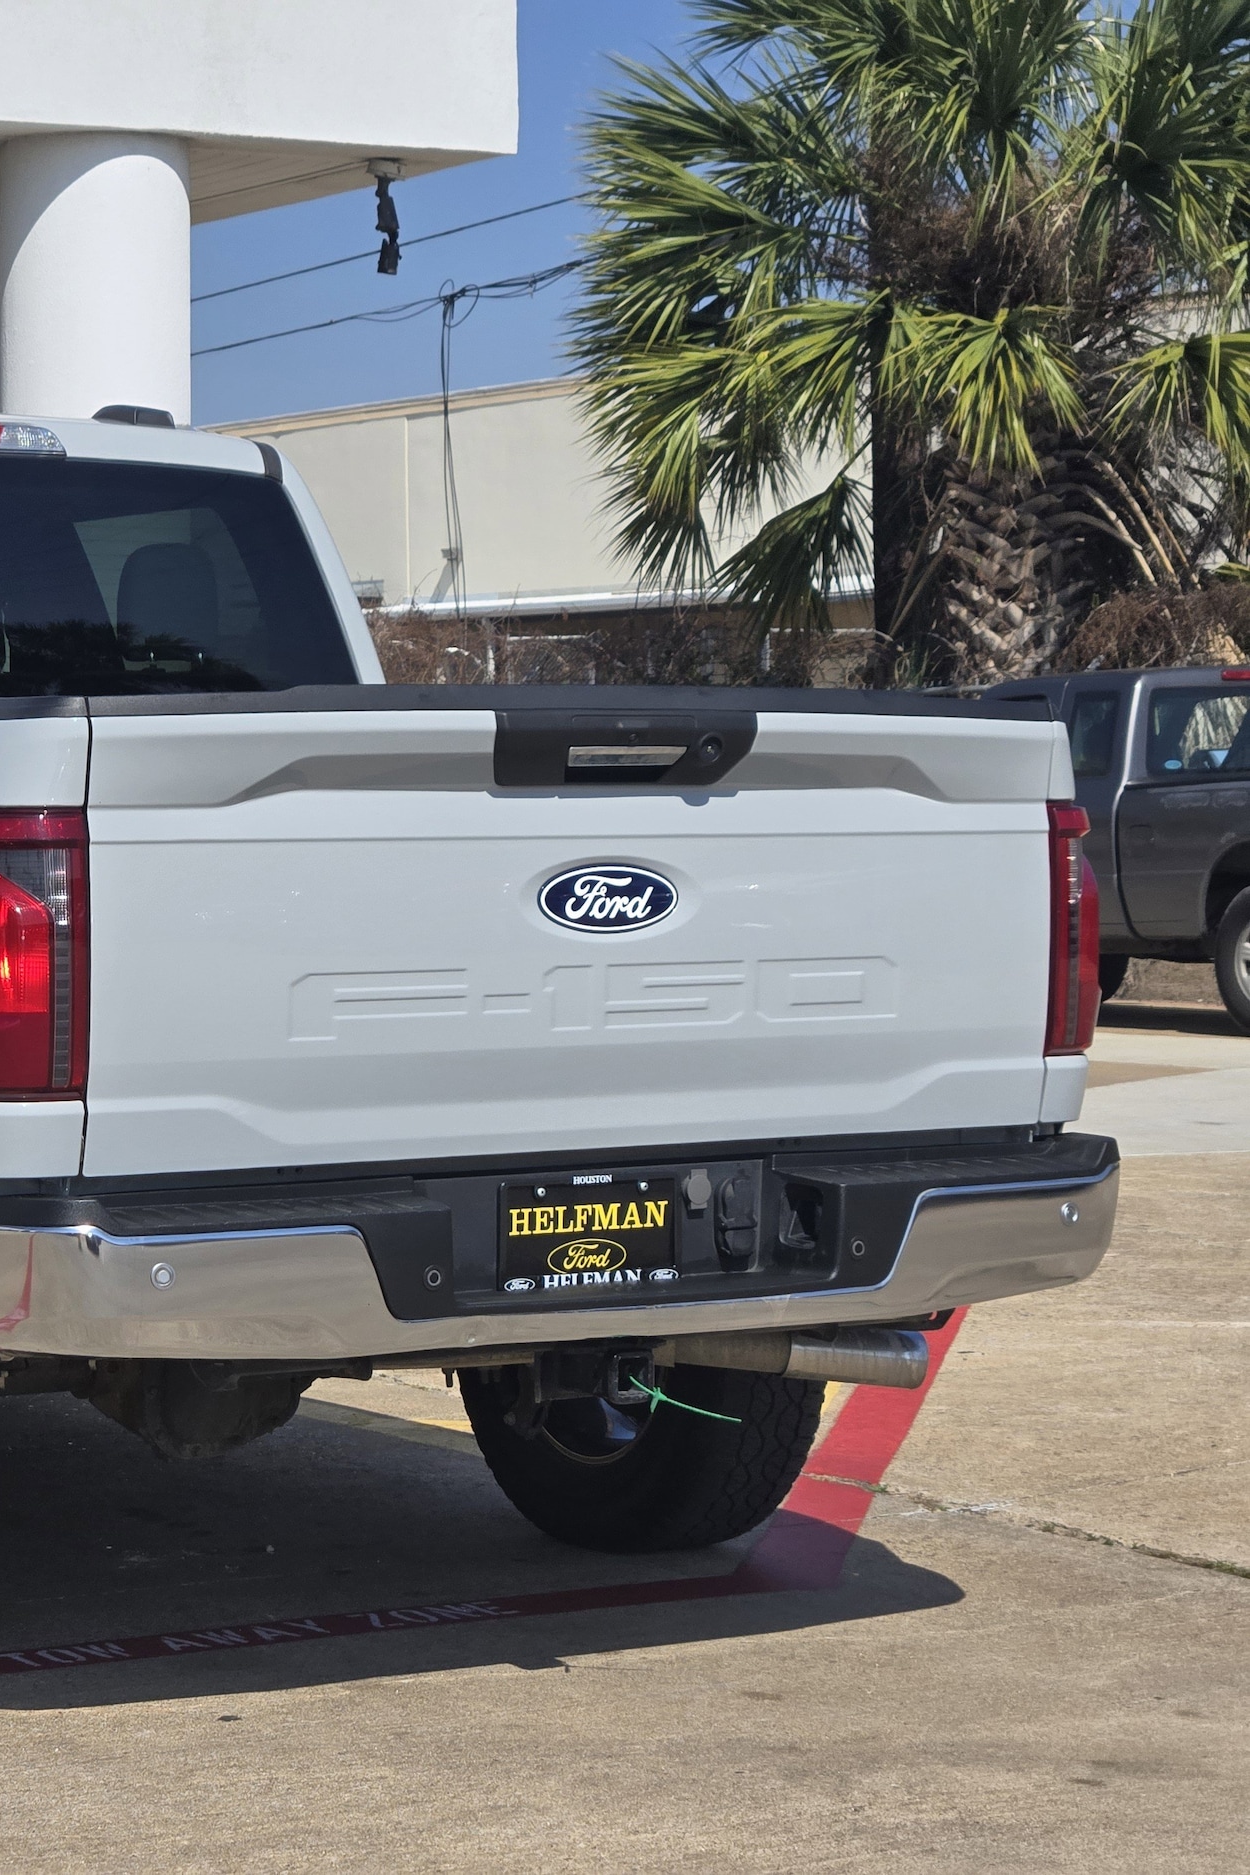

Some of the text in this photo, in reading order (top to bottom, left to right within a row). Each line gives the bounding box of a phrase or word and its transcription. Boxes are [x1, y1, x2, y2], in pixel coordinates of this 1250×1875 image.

[565, 875, 655, 921] Ford
[288, 955, 898, 1042] F-150
[572, 1174, 613, 1185] HOUSTON
[508, 1200, 669, 1237] HELFMAN
[562, 1243, 612, 1271] Ford
[543, 1269, 642, 1289] HELFMAN
[162, 1618, 331, 1653] AWAY
[348, 1599, 523, 1629] ZONE
